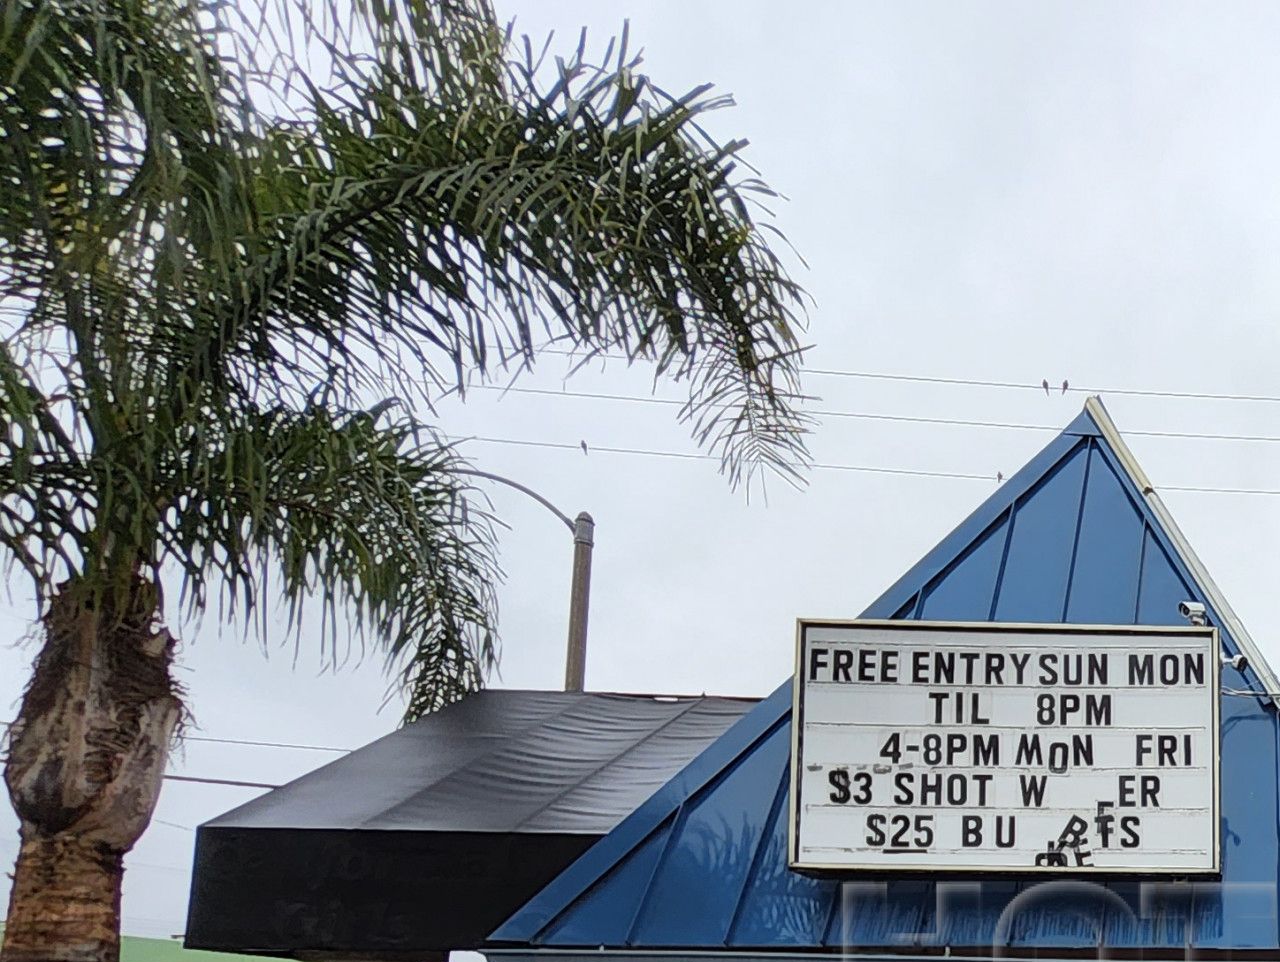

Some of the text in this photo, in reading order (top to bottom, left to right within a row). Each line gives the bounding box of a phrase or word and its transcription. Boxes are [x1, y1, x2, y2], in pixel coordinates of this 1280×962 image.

[809, 648, 1204, 686] FREE ENTRY SUN MON
[928, 691, 1112, 726] TIL 8PM
[879, 732, 1192, 774] 4-8PM MON FRI
[893, 772, 994, 807] SHOT
[866, 813, 934, 848] $25
